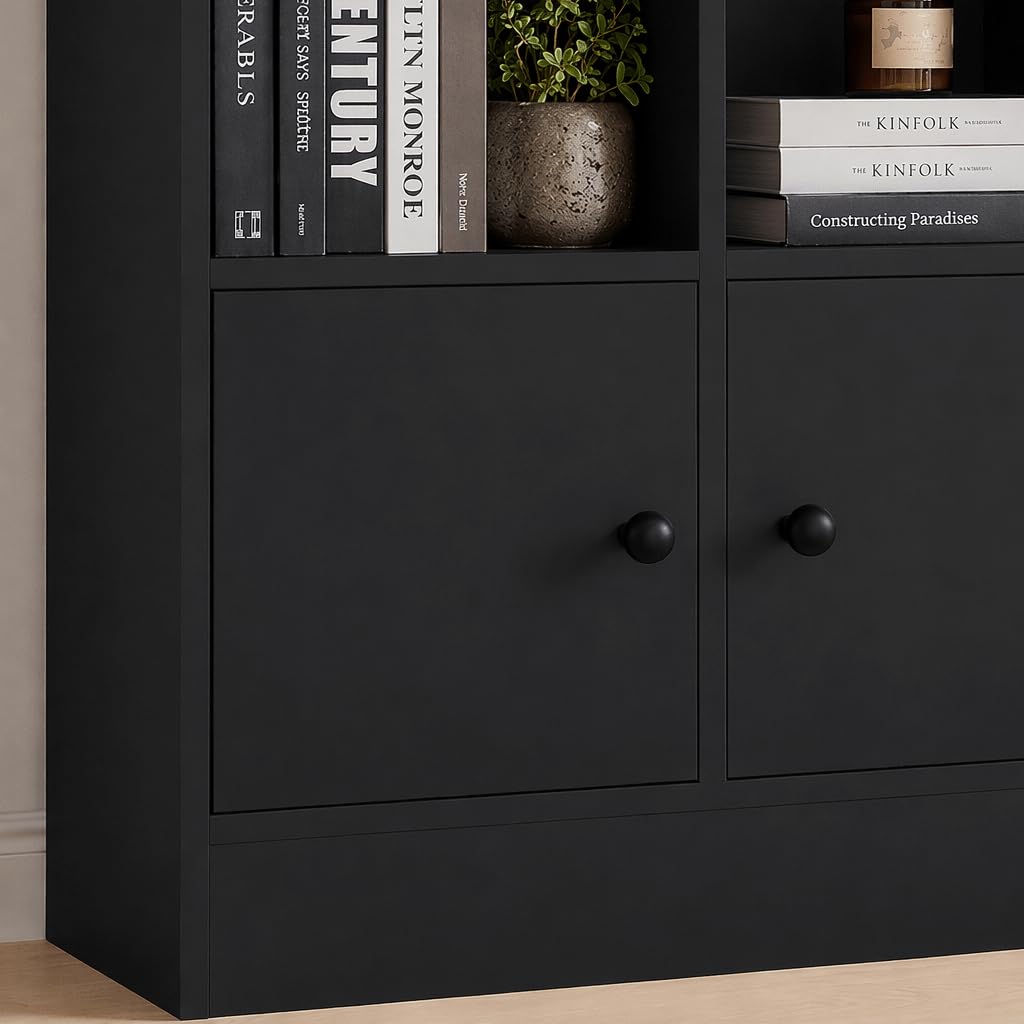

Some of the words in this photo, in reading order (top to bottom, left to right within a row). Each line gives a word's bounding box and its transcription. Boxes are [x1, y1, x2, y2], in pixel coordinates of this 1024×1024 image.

[296, 45, 310, 81] SAYS
[876, 116, 960, 130] KINFOLK
[403, 80, 424, 219] MONROE
[871, 163, 955, 177] KINFOLK
[810, 212, 907, 231] Constructing
[910, 210, 979, 227] Paradises
